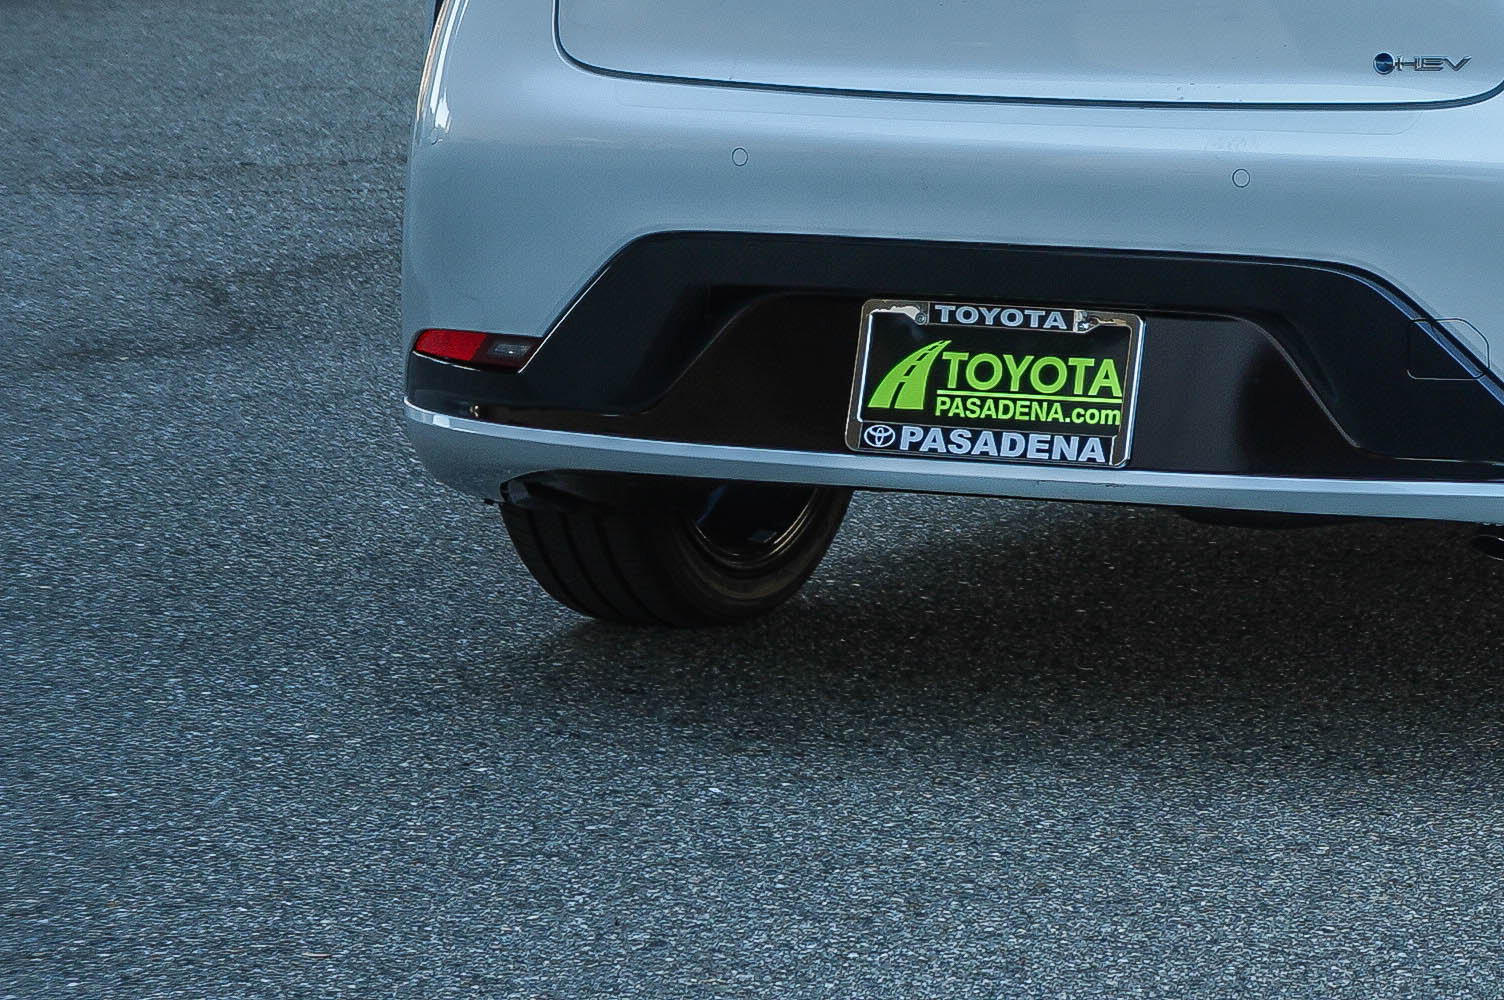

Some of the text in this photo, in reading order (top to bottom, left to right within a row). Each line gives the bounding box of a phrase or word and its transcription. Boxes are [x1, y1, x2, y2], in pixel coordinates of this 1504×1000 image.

[934, 304, 1067, 330] TOYOTA
[941, 351, 1123, 398] TOYOTA
[935, 397, 1122, 426] PASADENA.com
[899, 426, 1106, 463] PASADENA
